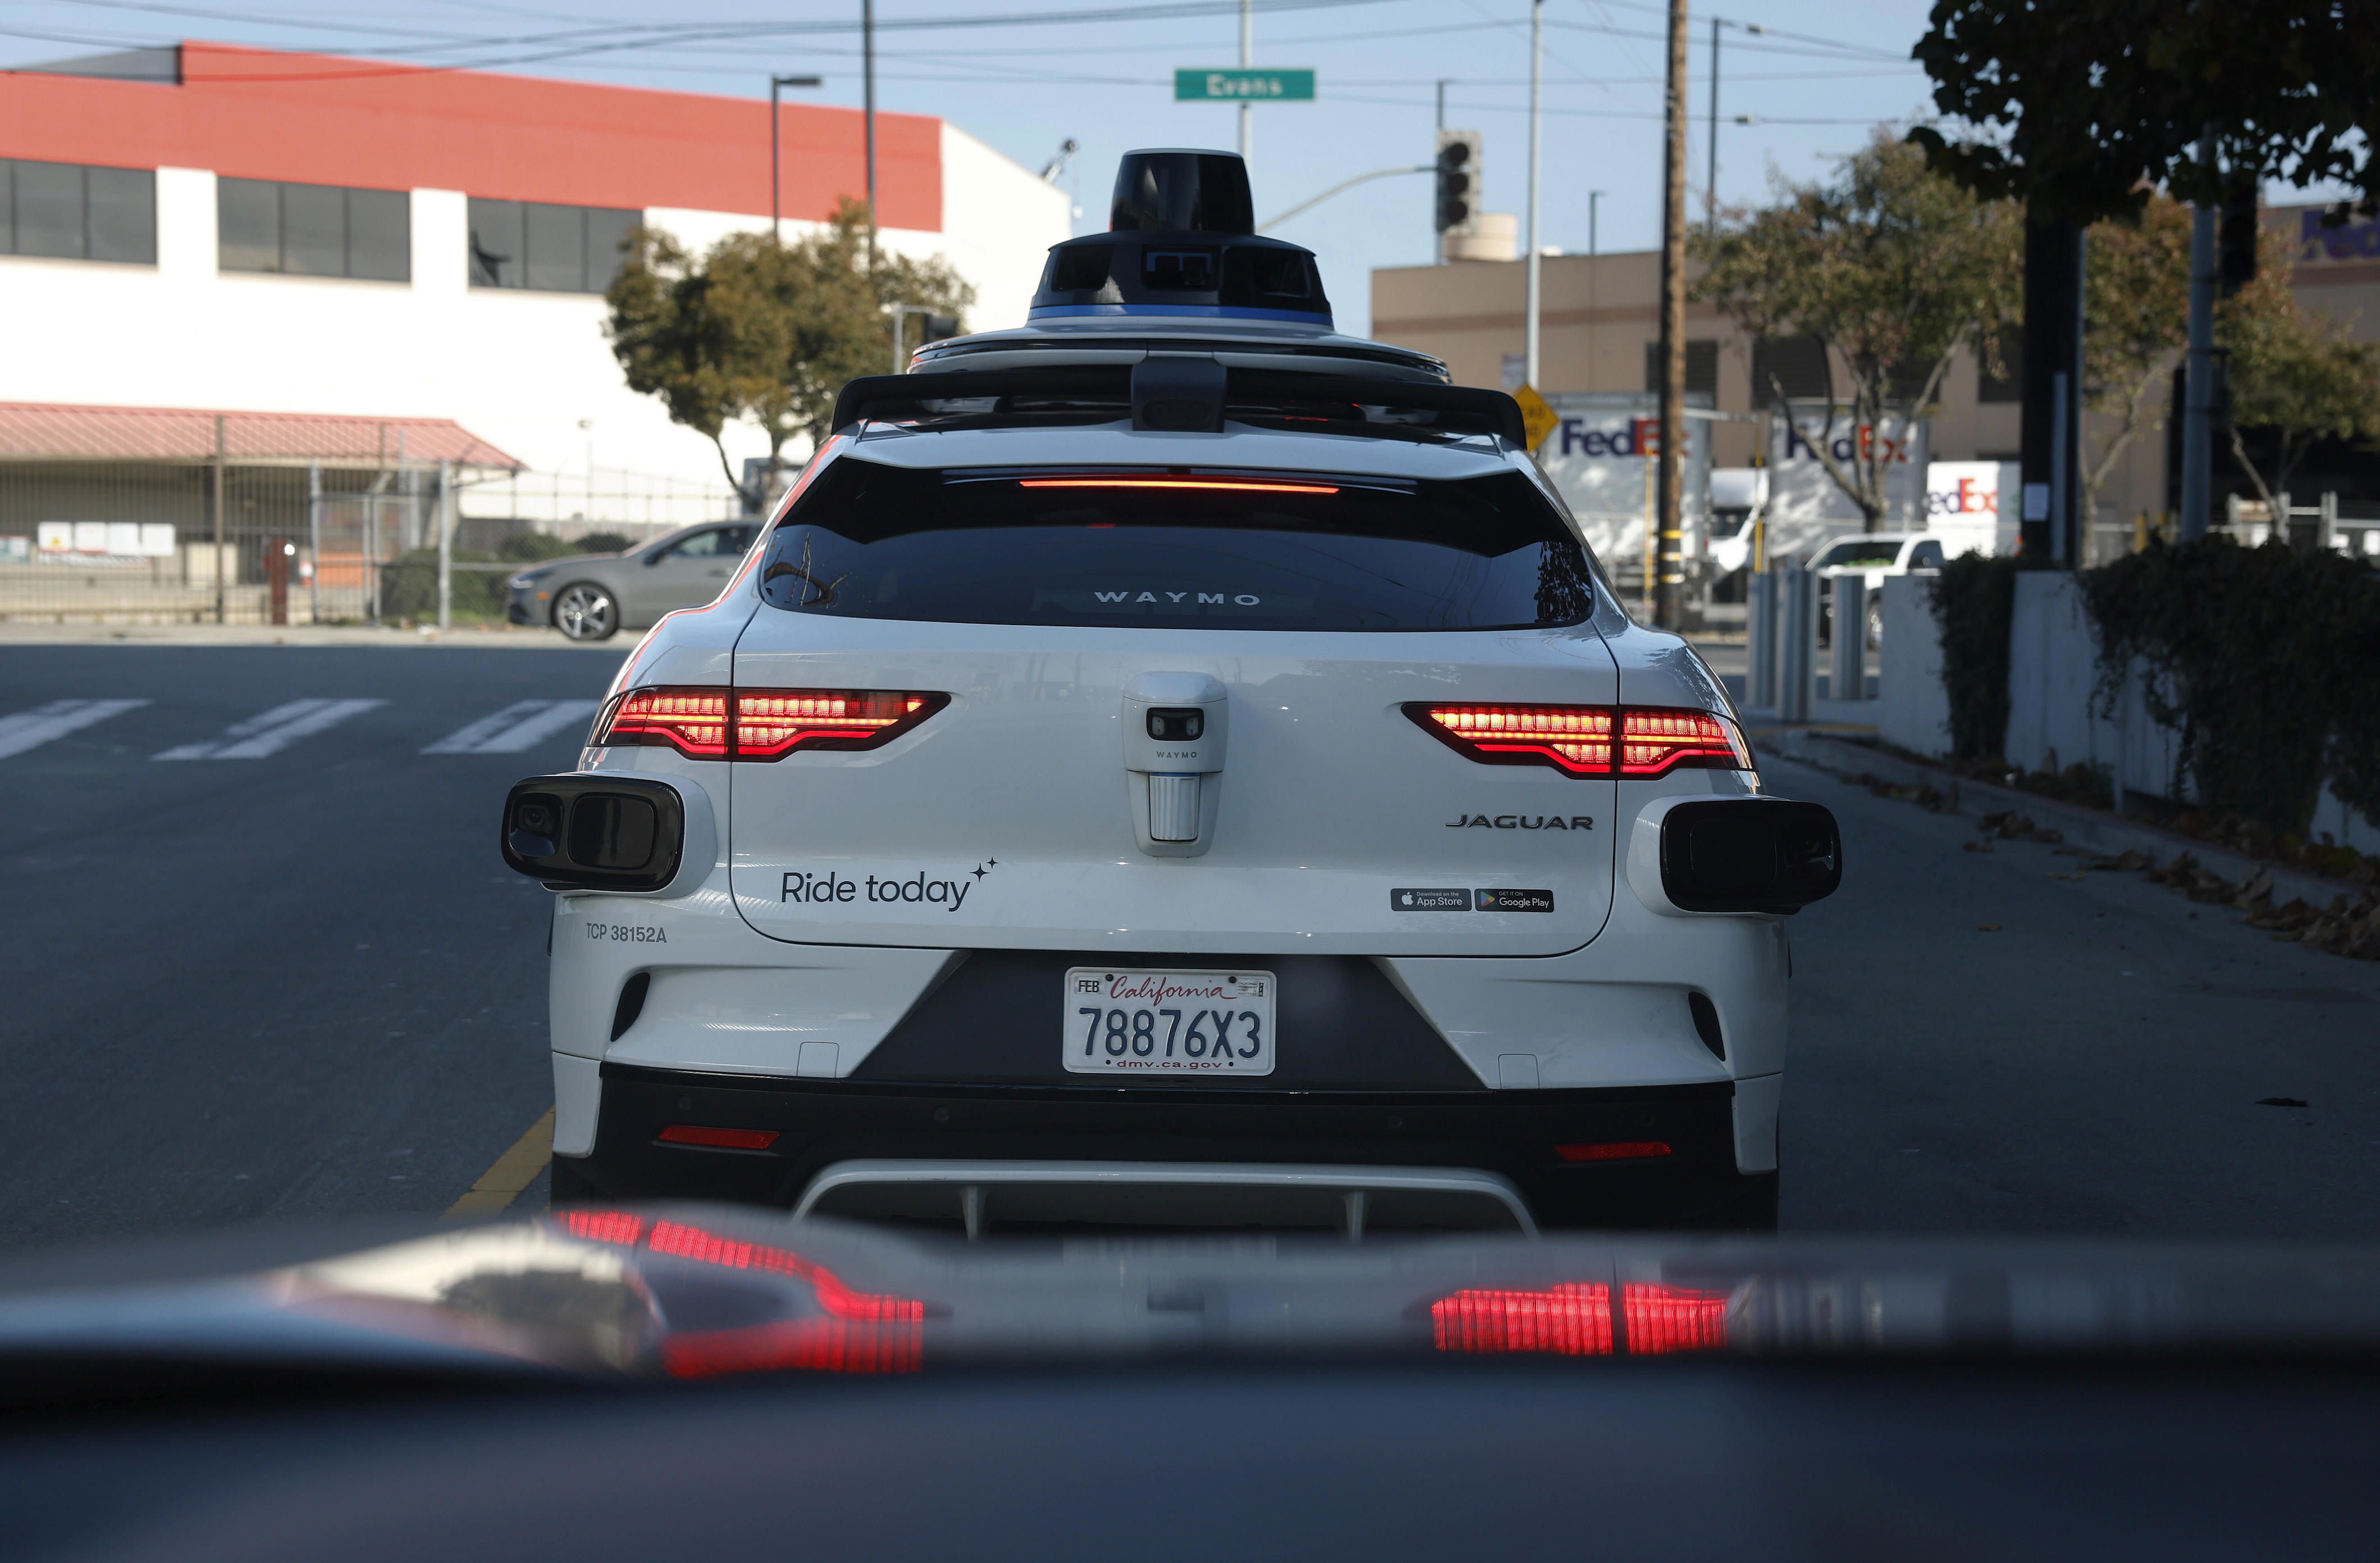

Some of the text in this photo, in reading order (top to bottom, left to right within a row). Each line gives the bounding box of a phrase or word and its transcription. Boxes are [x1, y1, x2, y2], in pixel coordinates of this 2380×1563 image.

[1207, 73, 1283, 96] Evans
[1094, 591, 1260, 606] WAYMO
[1445, 814, 1593, 830] JAGUAR
[782, 871, 971, 913] Ride today
[1417, 897, 1462, 907] App Store
[1499, 897, 1550, 909] Google Play
[587, 922, 667, 943] TCP 38152A
[1079, 980, 1099, 992] FEB
[1109, 976, 1237, 1006] California
[1079, 1007, 1260, 1058] 78876X3
[1117, 1060, 1222, 1069] dmv.ca.gov
